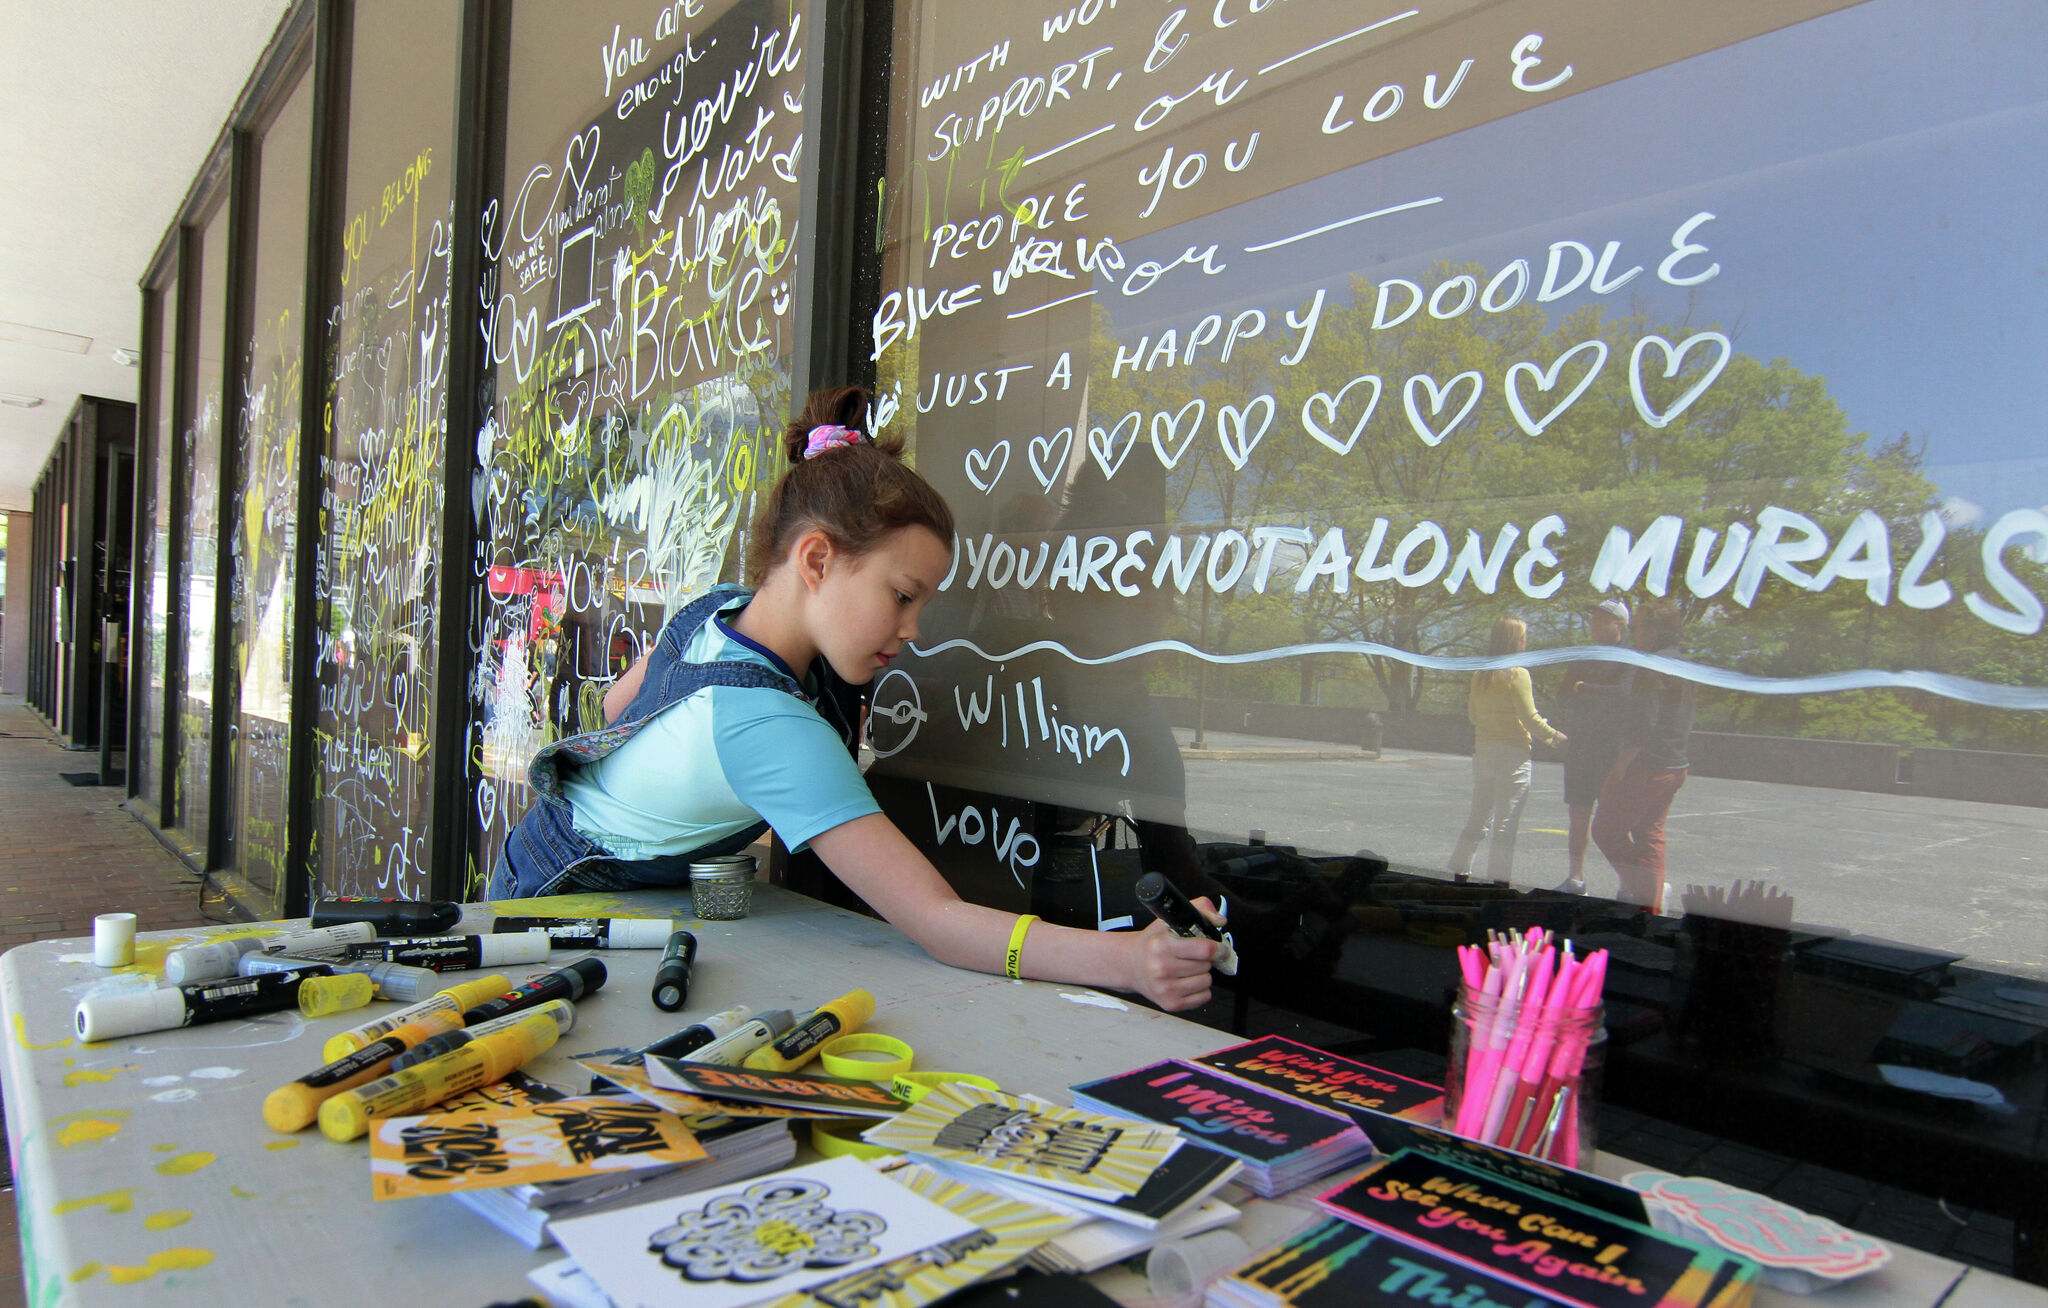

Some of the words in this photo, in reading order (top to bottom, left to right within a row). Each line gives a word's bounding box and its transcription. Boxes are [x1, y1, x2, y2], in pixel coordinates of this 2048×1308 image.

[921, 39, 1011, 109] WITH
[1042, 0, 1118, 43] WO
[1143, 8, 1190, 73] &
[929, 183, 1088, 268] PEOPLE
[1138, 131, 1260, 219] YOU
[1321, 33, 1574, 135] LOVE
[916, 366, 1035, 414] JUST
[1045, 351, 1073, 390] A
[1111, 289, 1326, 379] HAPPY
[1371, 211, 1721, 331] DOODLE
[955, 664, 1132, 777] William
[926, 781, 1041, 890] Love
[1008, 949, 1019, 969] YOU
[1146, 1071, 1195, 1088] I
[1161, 1083, 1276, 1124] Miss
[1234, 1058, 1317, 1083] Were
[1294, 1082, 1385, 1108] Here
[1257, 1049, 1337, 1075] Wish
[1366, 1179, 1441, 1207] See
[1492, 1239, 1647, 1295] Again
[1421, 1176, 1522, 1215] When
[1518, 1213, 1599, 1249] Can
[1594, 1243, 1629, 1265] I
